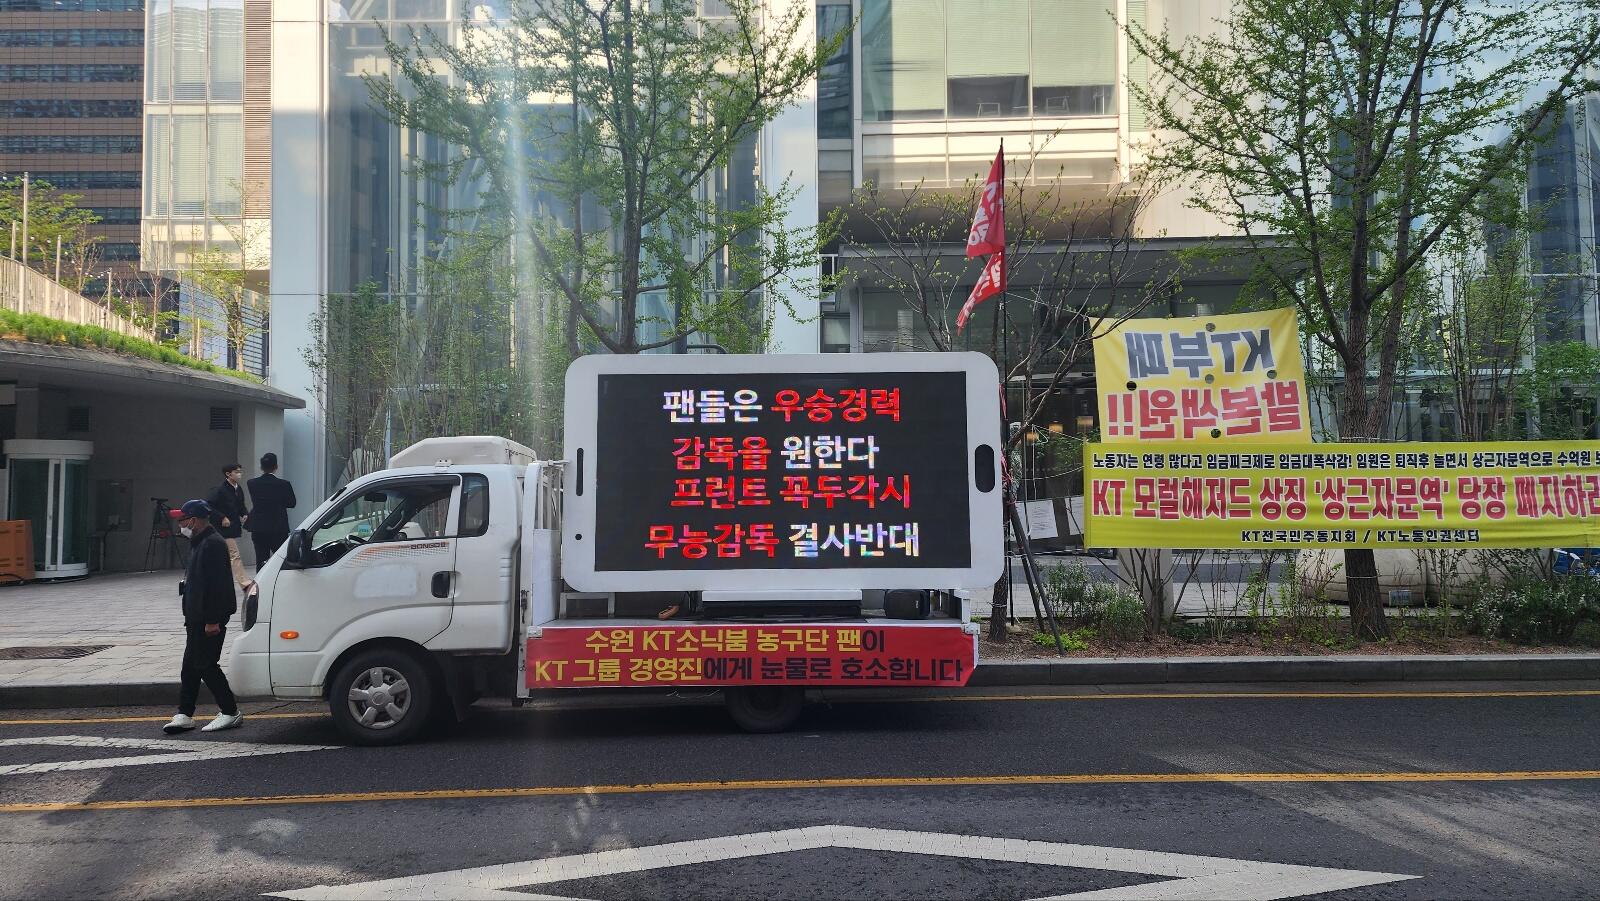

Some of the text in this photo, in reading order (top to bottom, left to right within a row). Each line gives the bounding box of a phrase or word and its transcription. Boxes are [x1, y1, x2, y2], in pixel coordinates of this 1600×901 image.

[662, 387, 901, 424] 팬들은 우승경력
[672, 435, 880, 471] 감독을 원한다
[1093, 453, 1139, 470] 노동자는
[1142, 453, 1165, 470] 연령
[1168, 453, 1203, 470] 많다고
[1206, 453, 1275, 470] 임금피크제로
[1279, 453, 1352, 470] 임금대폭삭감!
[1356, 453, 1391, 469] 임원은
[1395, 452, 1430, 469] 퇴직후
[1434, 452, 1468, 469] 놀면서
[1472, 451, 1553, 468] 상근자문역으로
[1557, 450, 1591, 466] 수억원
[670, 474, 911, 509] 프런트 꼭두각시
[1092, 479, 1127, 517] KT
[1133, 477, 1252, 520] 모럴해저드
[1259, 477, 1307, 521] 상징
[1315, 476, 1449, 521] '상근자문역'
[1458, 476, 1506, 520] 당장
[644, 522, 920, 559] 무능감독 결사반대
[1241, 530, 1357, 543] KT전국민주동지회
[1377, 529, 1480, 543] KT노동인권센터
[585, 629, 886, 654] 수원 KT소닉붐 농구단 팬이
[629, 656, 753, 682] 경영진에게
[761, 657, 833, 680] 눈물로
[840, 657, 965, 682] 호소합니다
